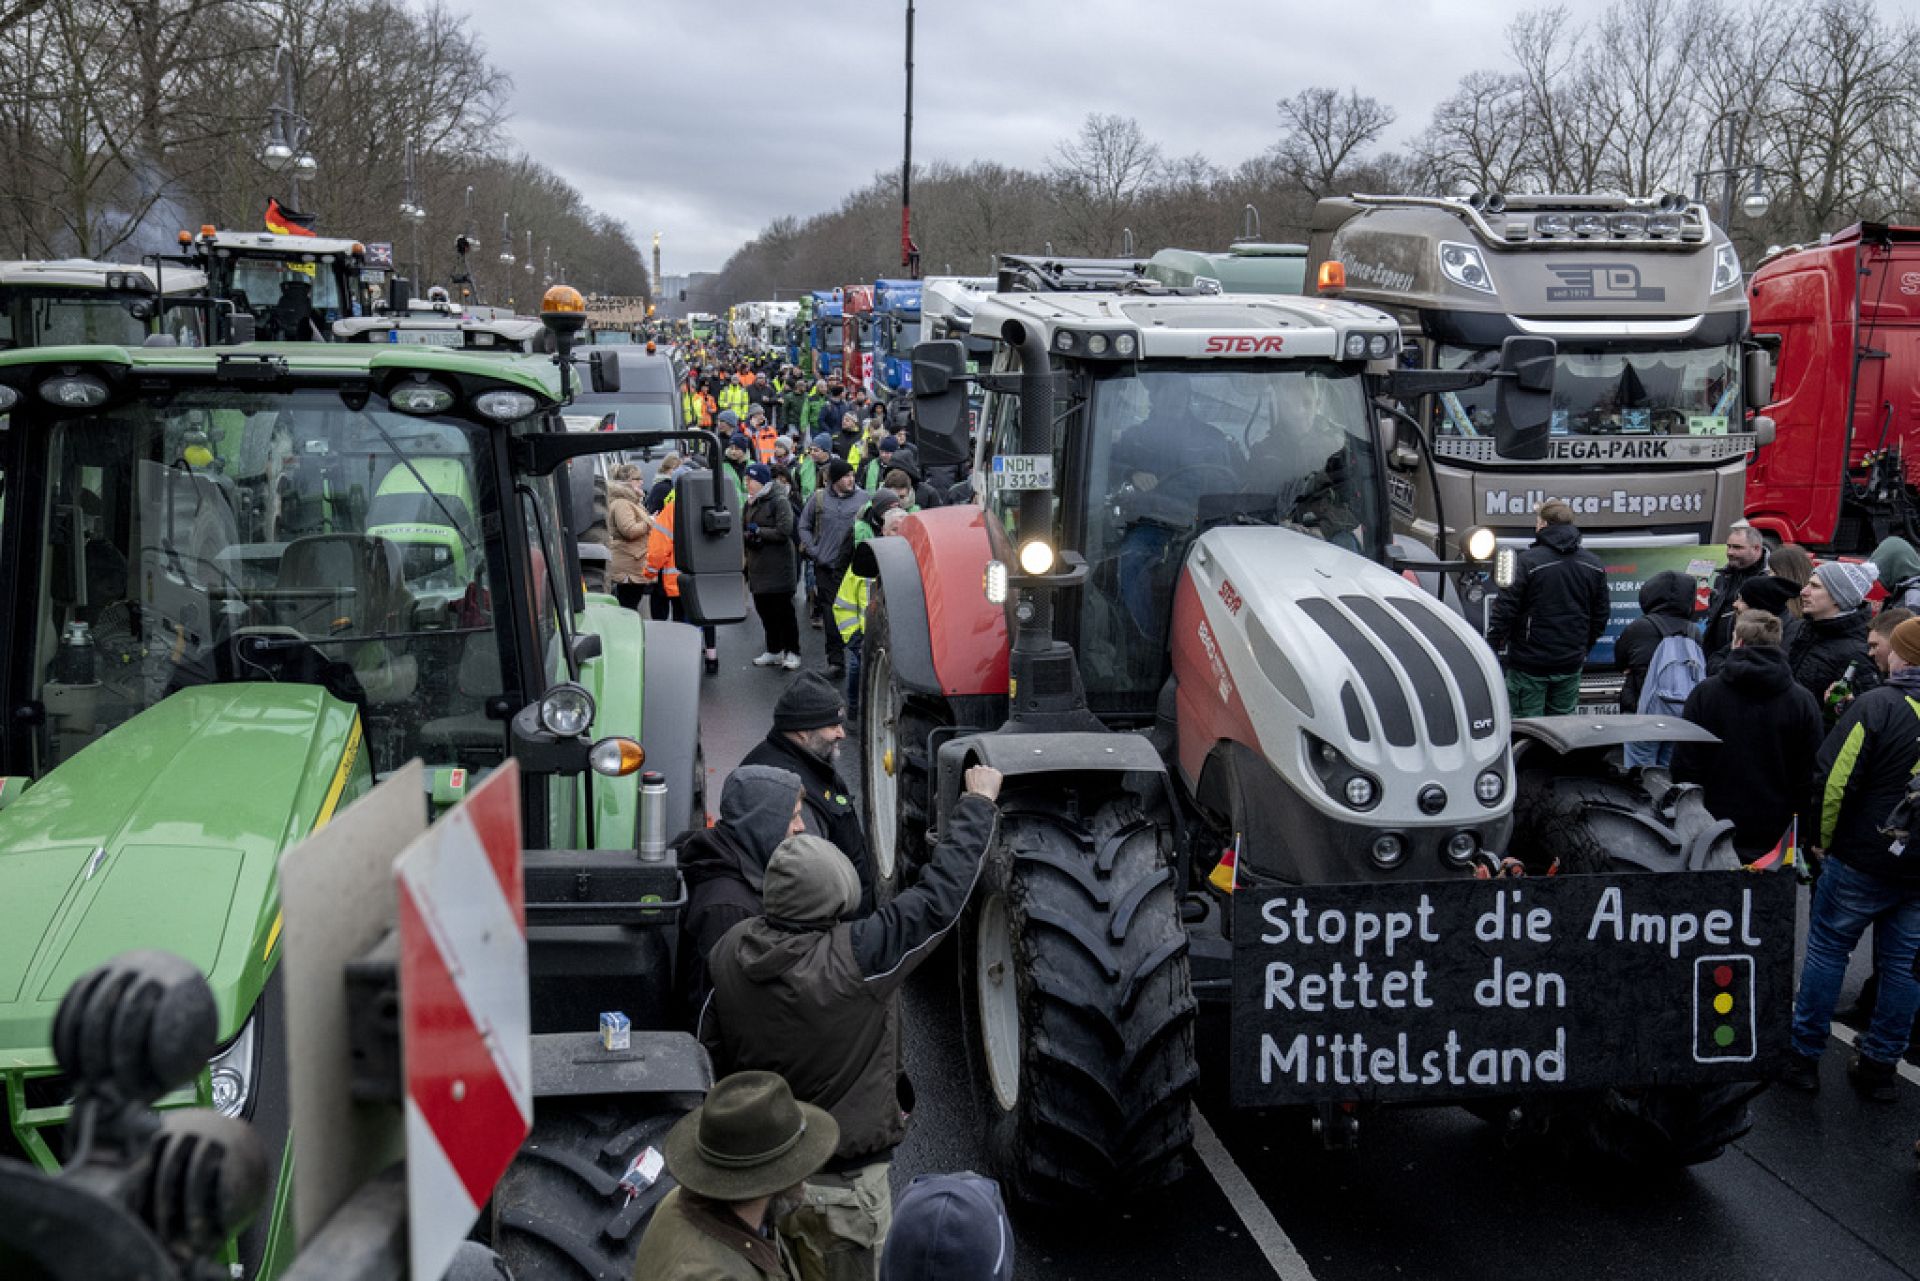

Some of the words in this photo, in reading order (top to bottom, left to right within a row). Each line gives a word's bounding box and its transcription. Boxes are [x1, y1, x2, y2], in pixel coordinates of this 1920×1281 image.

[1205, 335, 1284, 353] STEYR
[1006, 458, 1034, 472] NDH
[1260, 894, 1440, 957] Stoppt
[1474, 890, 1553, 943] die
[1587, 886, 1762, 959] Ampel
[1264, 959, 1434, 1012] Rettet
[1473, 956, 1566, 1009] den
[1260, 1026, 1566, 1085] Mittelstand
